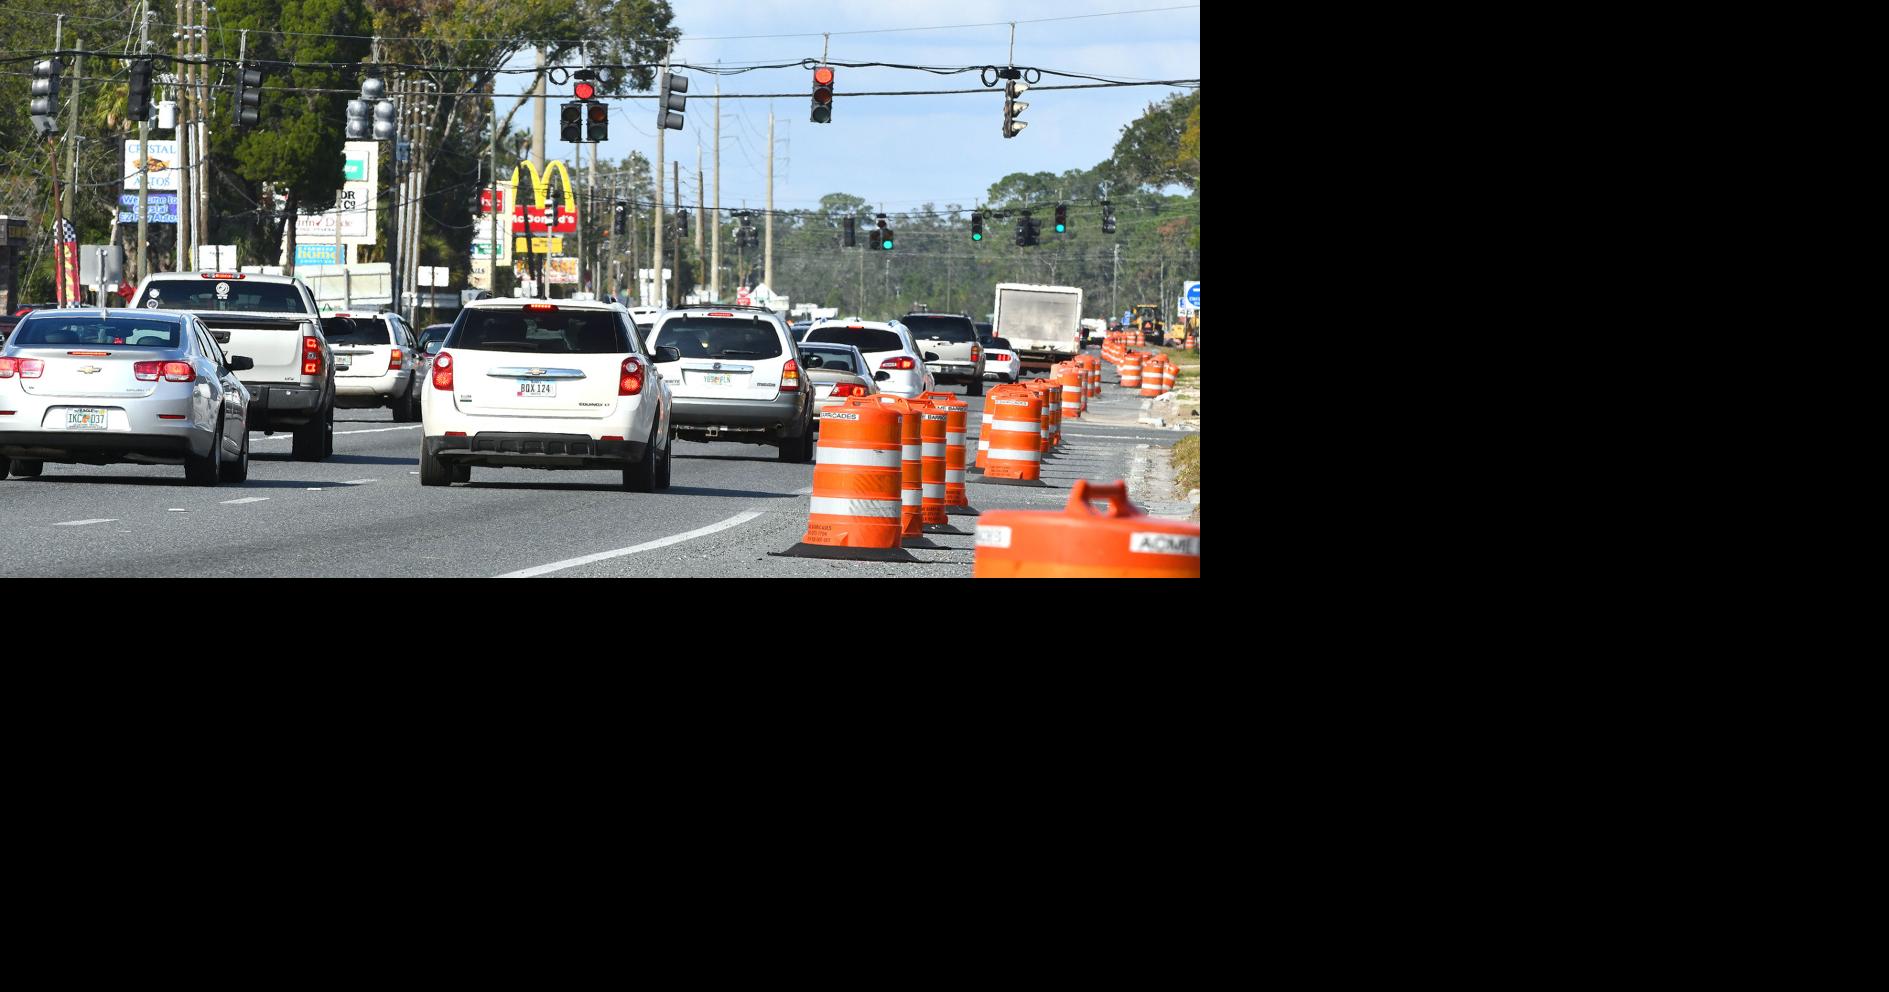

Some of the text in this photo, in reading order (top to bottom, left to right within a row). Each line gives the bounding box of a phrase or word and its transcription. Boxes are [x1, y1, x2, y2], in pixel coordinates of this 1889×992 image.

[128, 144, 176, 154] CRSTAL
[134, 176, 170, 187] ATOS
[512, 213, 575, 224] McDond's
[537, 384, 550, 393] 124
